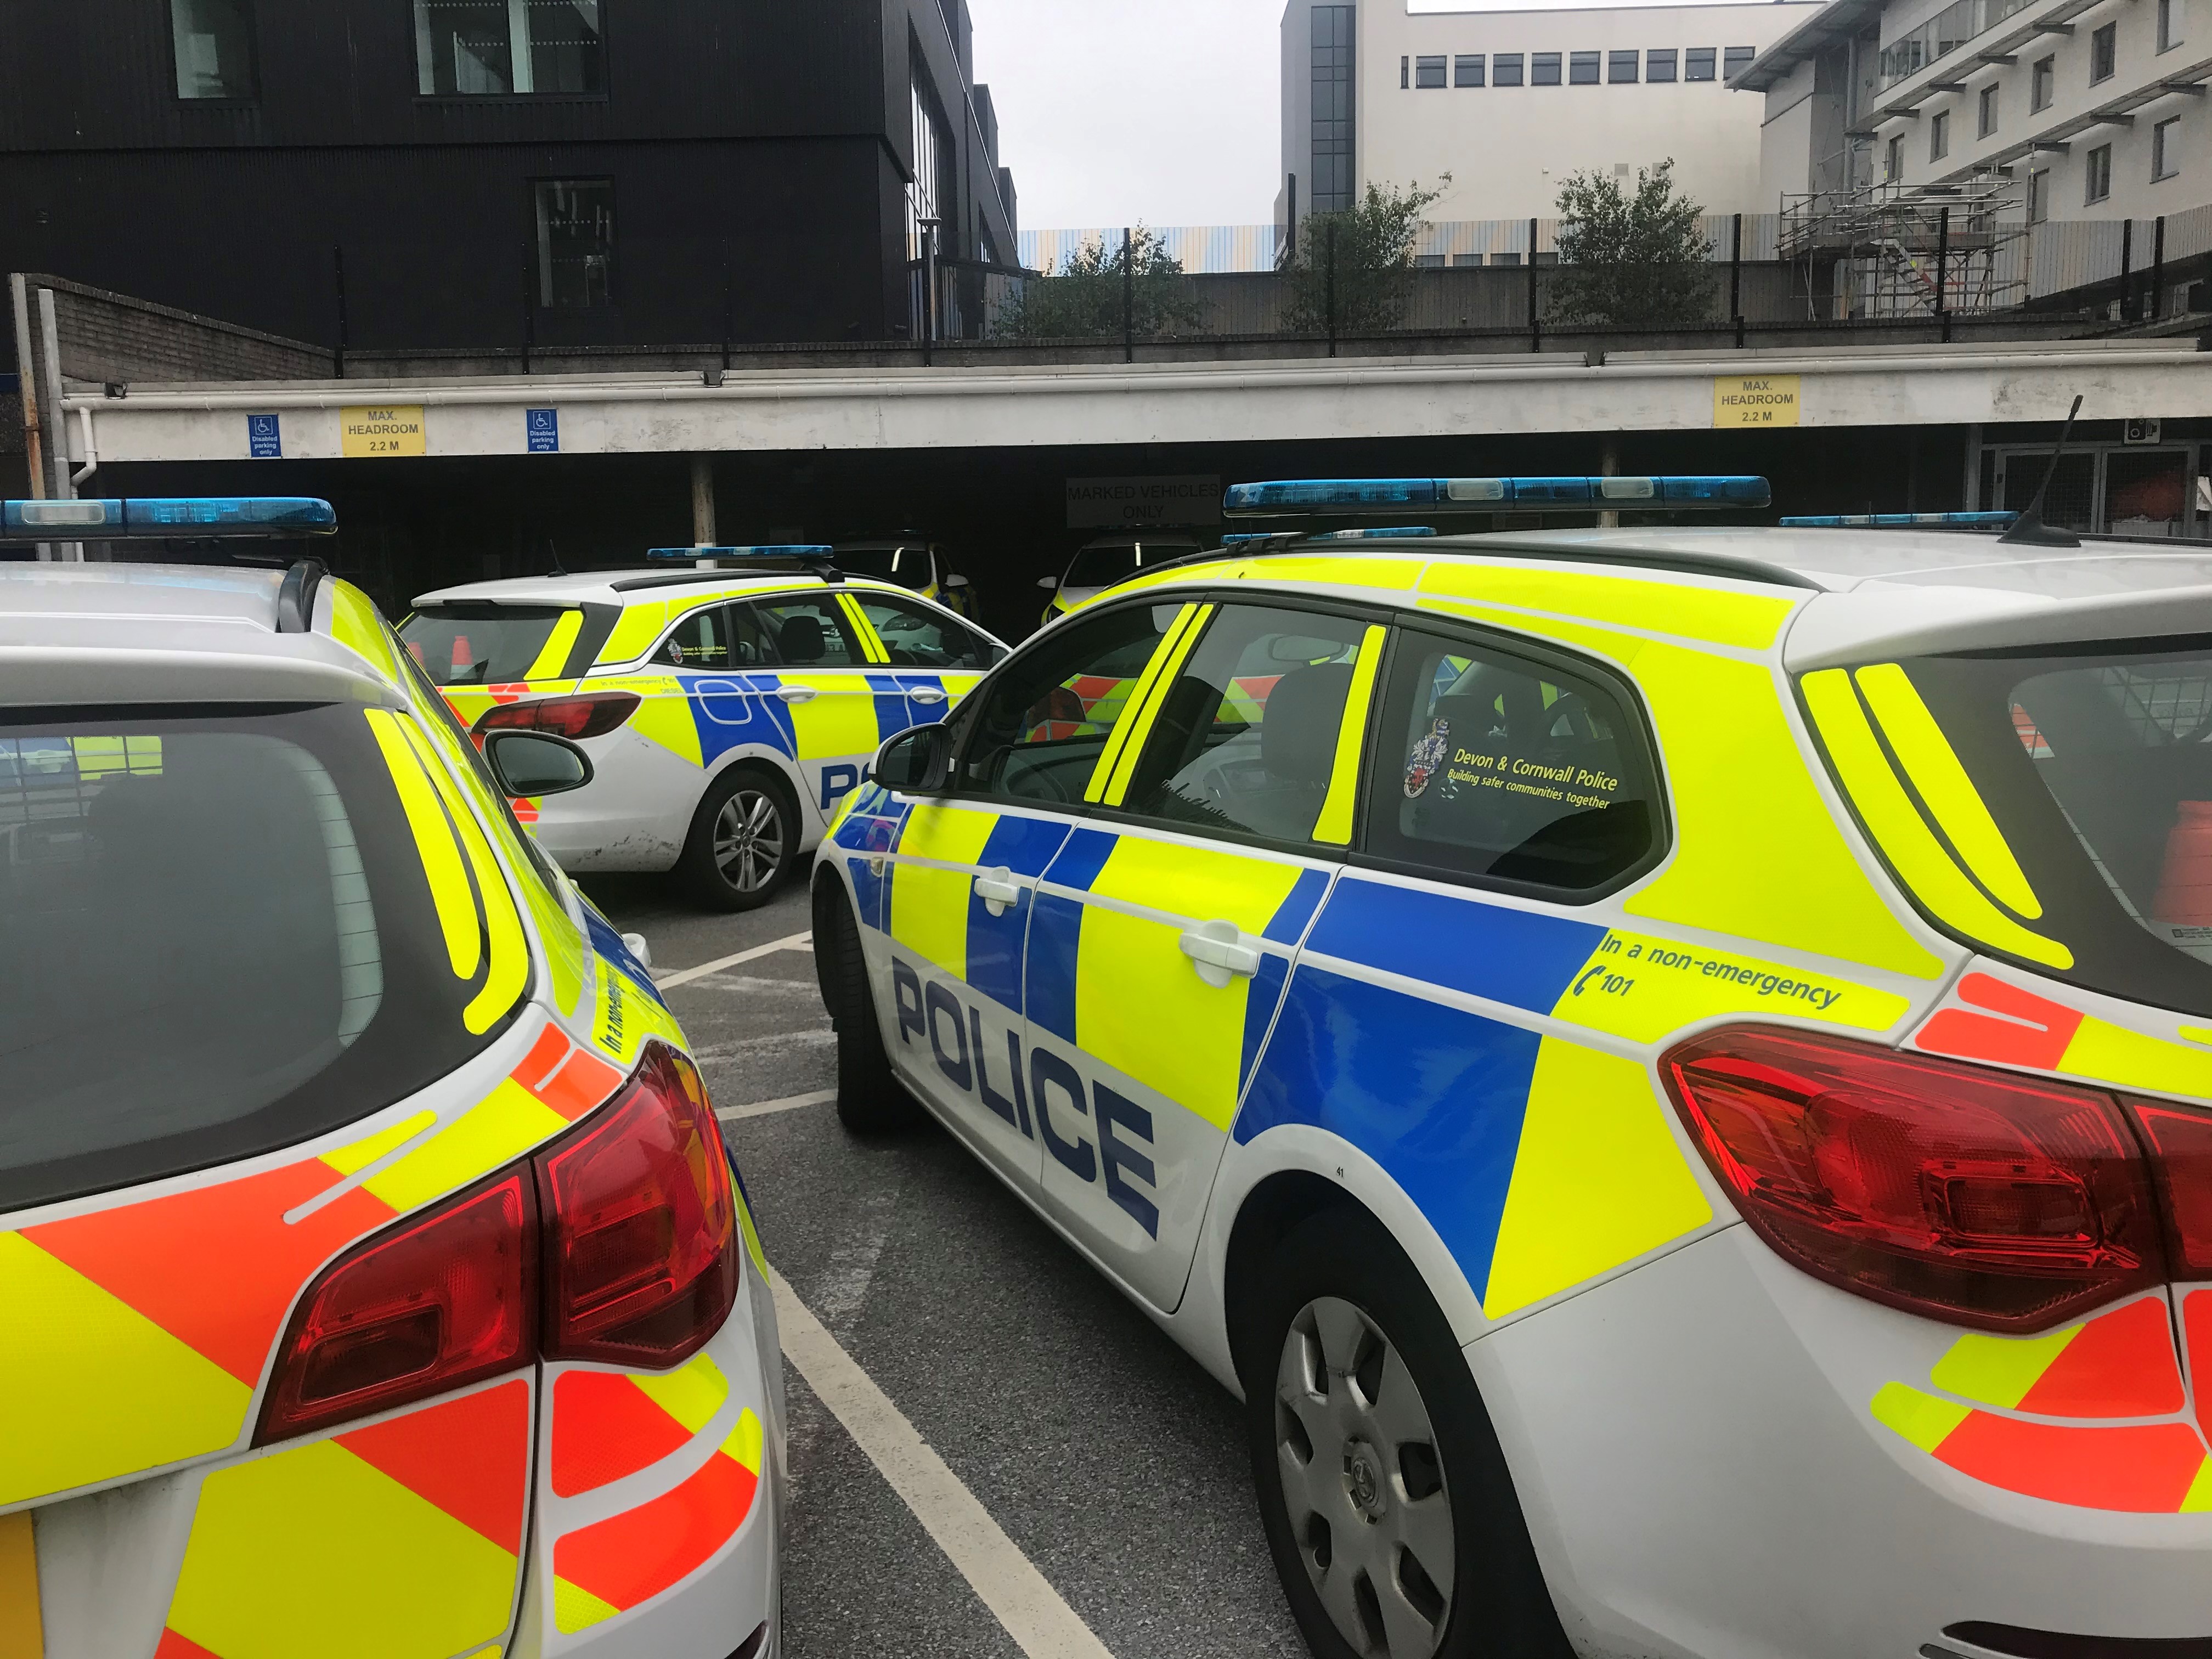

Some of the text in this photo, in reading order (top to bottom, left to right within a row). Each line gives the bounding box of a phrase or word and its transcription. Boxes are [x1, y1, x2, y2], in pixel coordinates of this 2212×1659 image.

[1743, 381, 1773, 391] MAX.
[1722, 394, 1793, 405] HEADROOM
[368, 410, 397, 421] MAX.
[1742, 411, 1772, 422] 2.2 M
[348, 424, 419, 435] HEADROOM
[370, 441, 399, 451] 2.2 M
[1068, 483, 1219, 500] MARKED VEHICLES
[1123, 505, 1164, 518] ONLY
[1453, 748, 1618, 791] Devon & Cornwall Police
[1447, 768, 1610, 809] Building safer communities together
[1600, 934, 1842, 1010] In a non-emergency
[1600, 973, 1635, 996] 101
[599, 1034, 622, 1054] In
[892, 955, 1159, 1242] POLICE
[1336, 1166, 1344, 1177] 41
